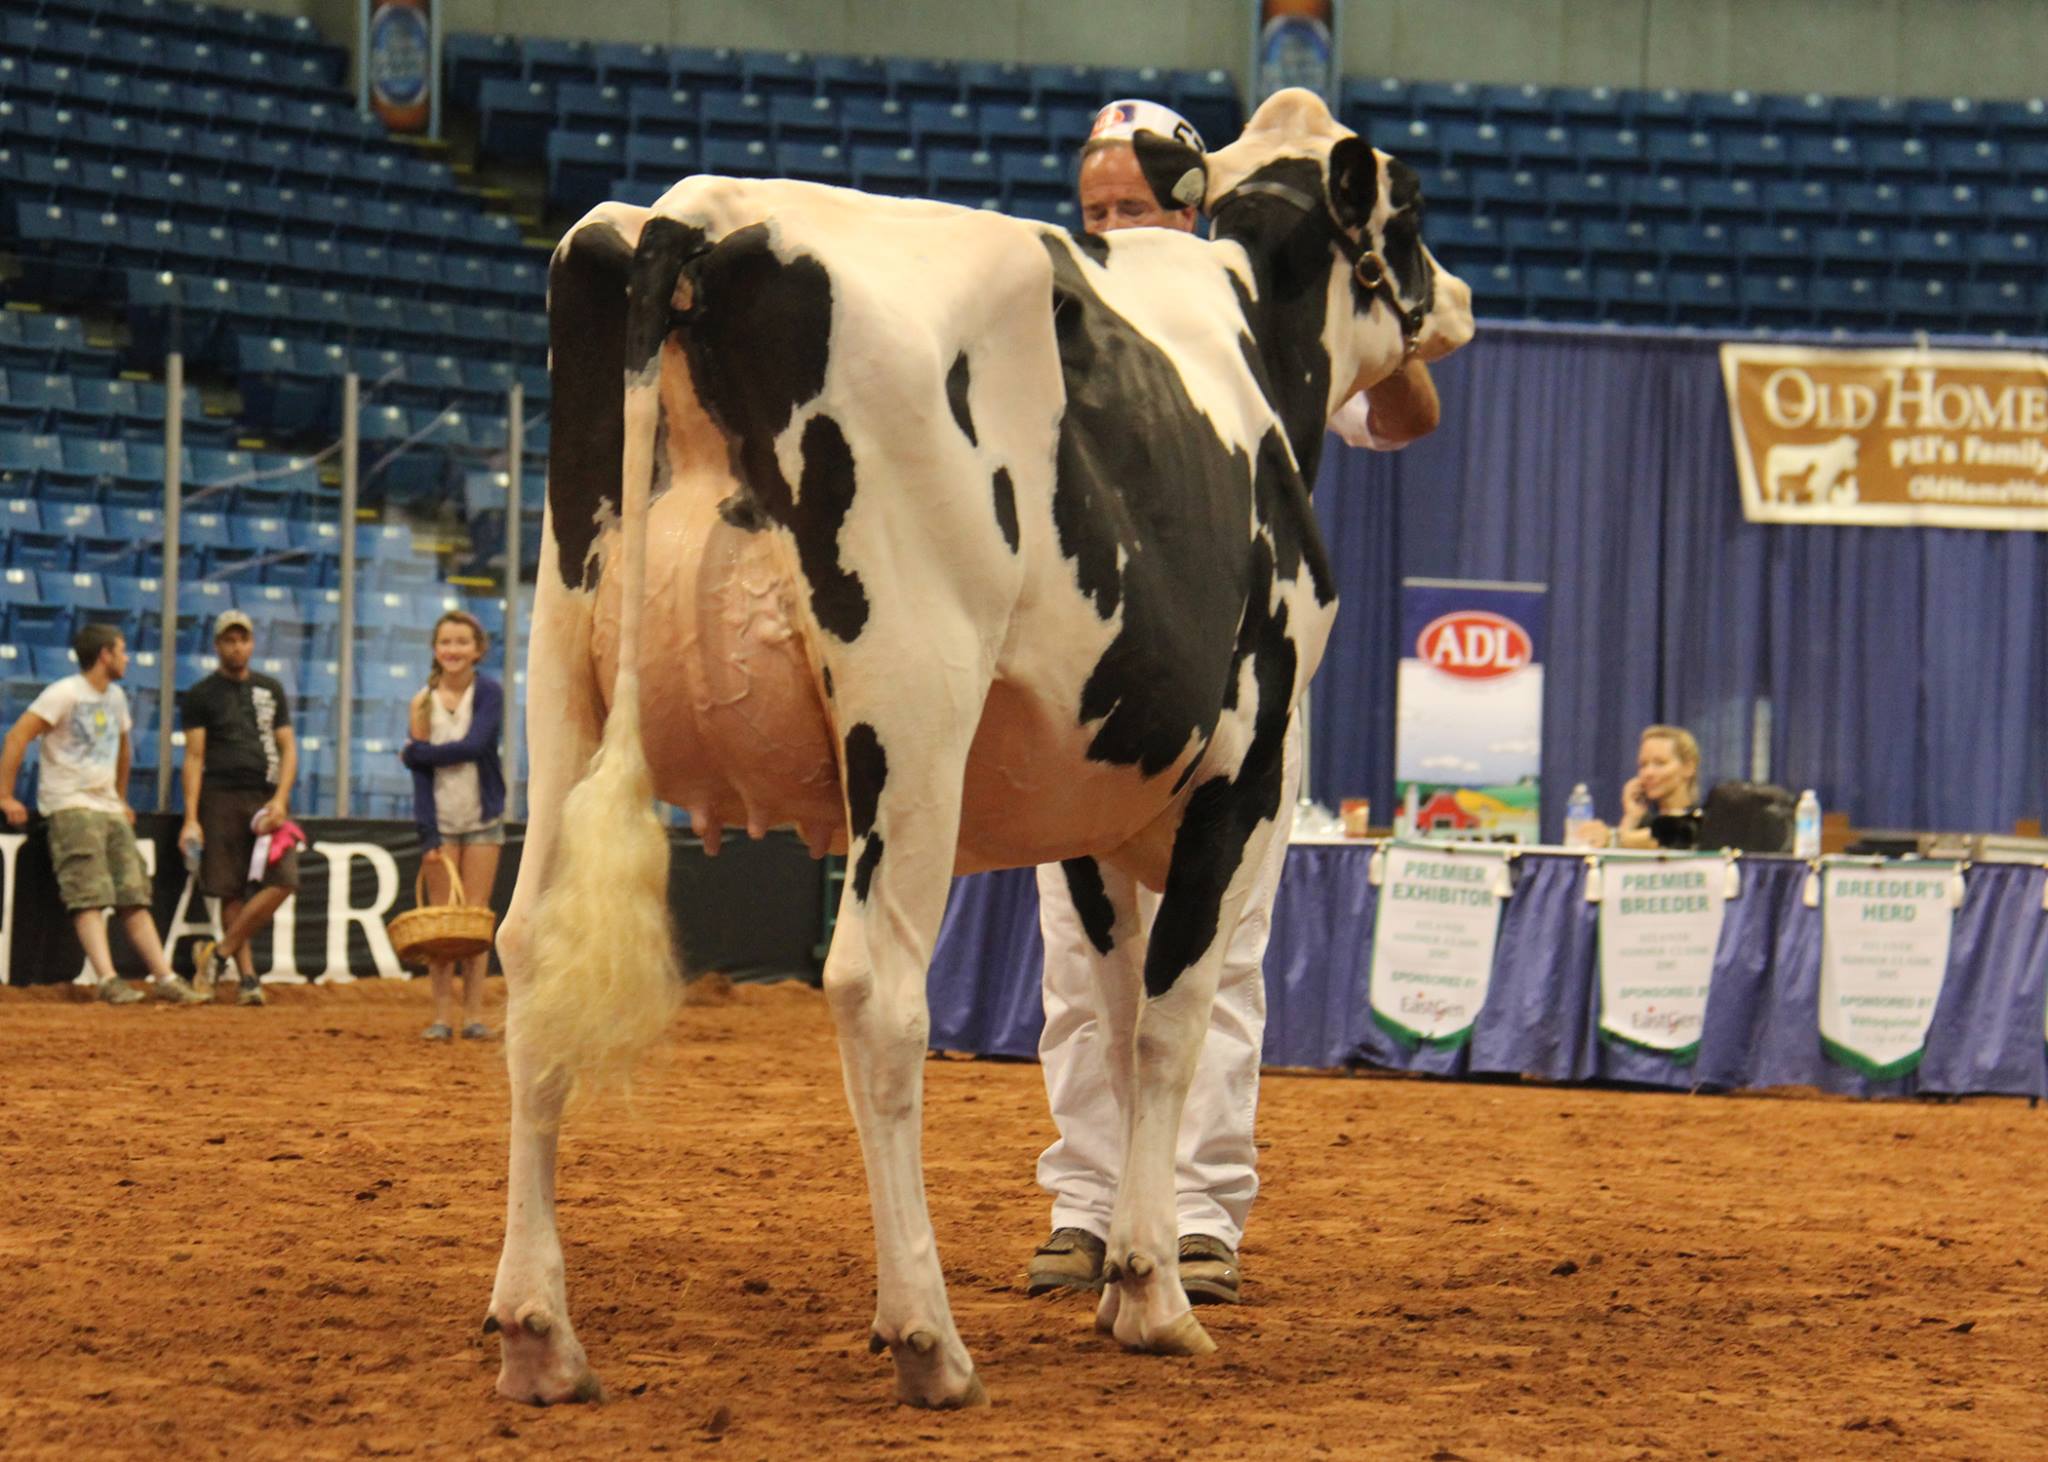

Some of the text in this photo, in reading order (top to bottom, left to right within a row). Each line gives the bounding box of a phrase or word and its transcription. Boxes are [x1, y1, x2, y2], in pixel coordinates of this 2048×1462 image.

[1432, 624, 1521, 668] ADL
[1404, 861, 1486, 882] PREMIER
[1622, 872, 1706, 890] PREMIER
[1836, 880, 1944, 898] BREEDER'S
[1392, 883, 1493, 906] EXHIBITOR
[1620, 896, 1709, 914] BREEDER
[1862, 904, 1916, 921] HERD
